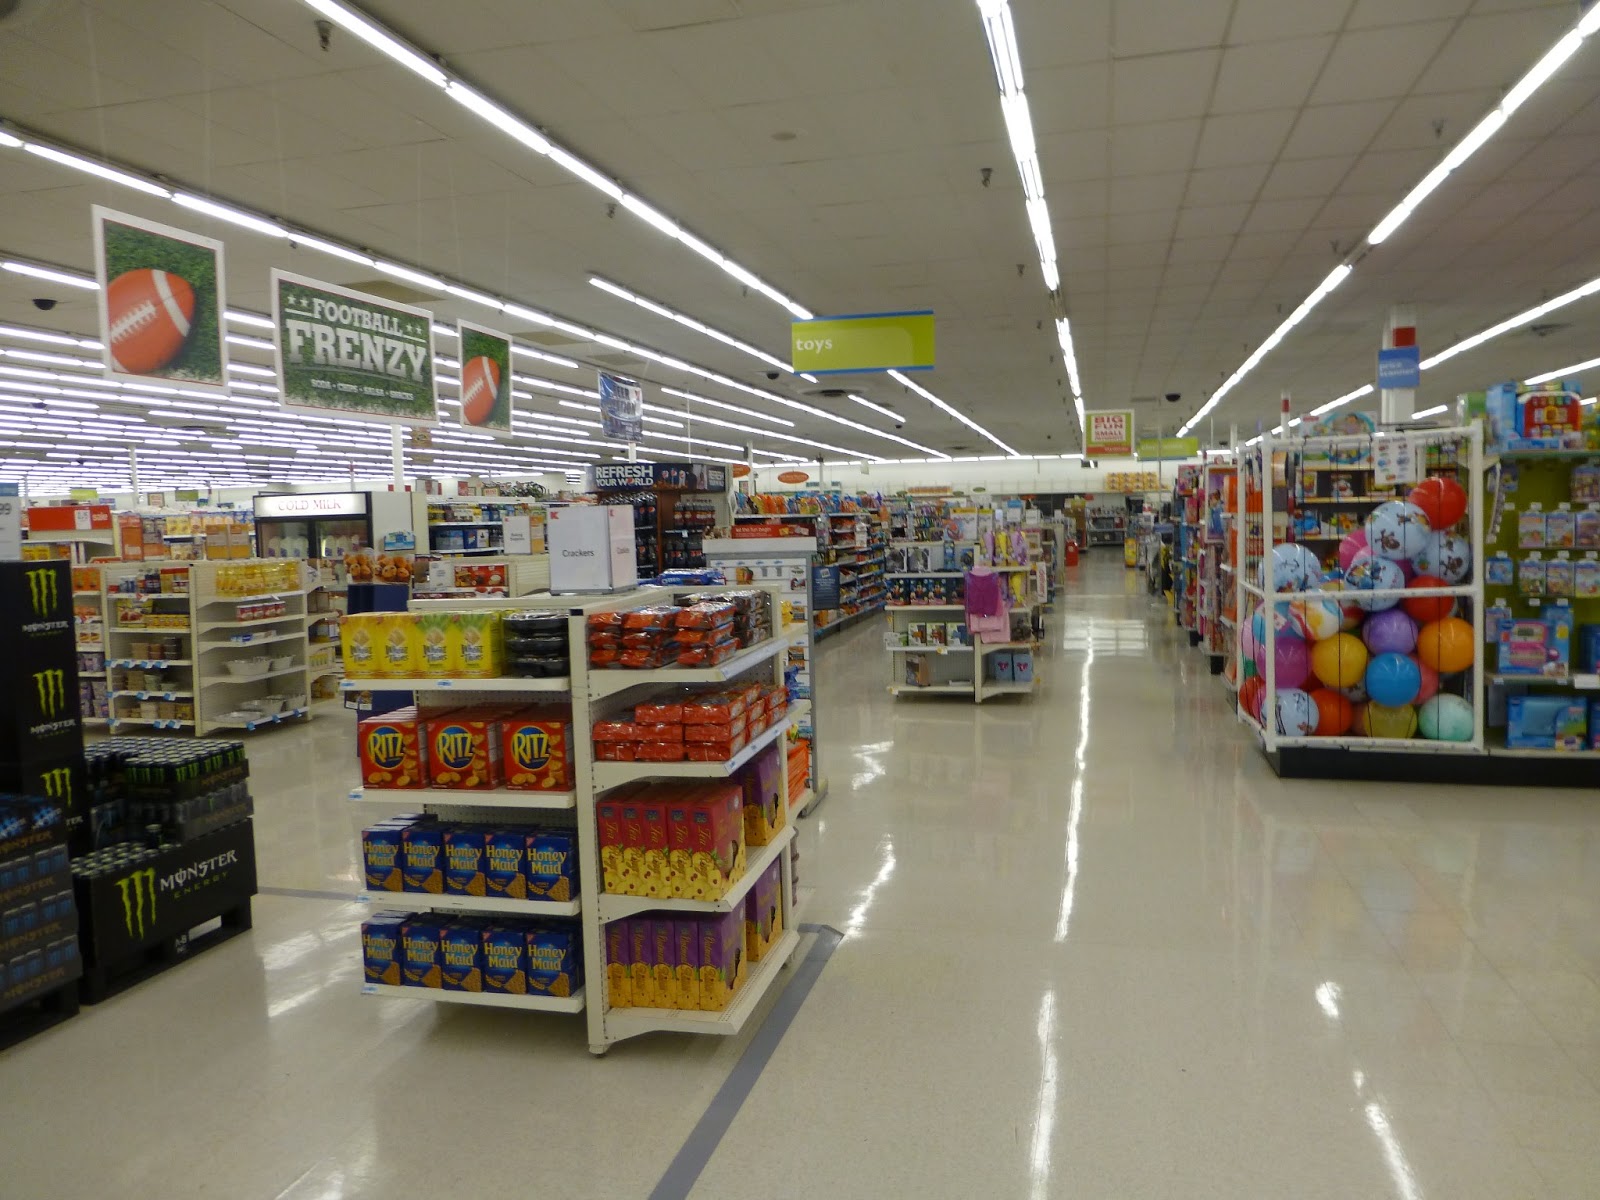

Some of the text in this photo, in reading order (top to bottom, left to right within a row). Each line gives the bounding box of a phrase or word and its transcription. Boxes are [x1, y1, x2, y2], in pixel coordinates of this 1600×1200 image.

[313, 298, 403, 336] FOOTBALL
[286, 319, 427, 382] FRENZY
[796, 338, 833, 354] toys
[1094, 416, 1123, 424] BIG
[595, 466, 653, 478] REFRESH
[596, 477, 654, 486] YOUR WORLD
[278, 498, 341, 511] COLD MILK
[562, 549, 595, 557] Crackers
[22, 621, 69, 632] MONSTER
[31, 719, 76, 734] MONSTER
[368, 732, 404, 763] RITZ
[438, 732, 473, 763] RITZ
[513, 732, 549, 764] RITZ
[364, 842, 399, 855] Honey
[403, 842, 440, 856] Honey
[445, 844, 482, 859] Honey
[486, 845, 523, 860] Honey
[368, 854, 395, 866] Maid
[407, 855, 435, 868] Maid
[527, 848, 567, 864] Honey
[160, 850, 238, 891] MONSTER
[450, 857, 478, 870] Maid
[490, 858, 519, 872] Maid
[531, 861, 562, 875] Maid
[174, 872, 228, 898] ENERGY
[362, 934, 397, 949] Honey
[402, 937, 439, 952] Honey
[441, 940, 478, 955] Honey
[367, 947, 393, 960] Maid
[407, 950, 435, 962] Maid
[484, 943, 522, 957] Honey
[528, 945, 567, 959] Honey
[445, 952, 474, 966] Maid
[488, 955, 518, 968] Maid
[532, 958, 562, 971] Maid
